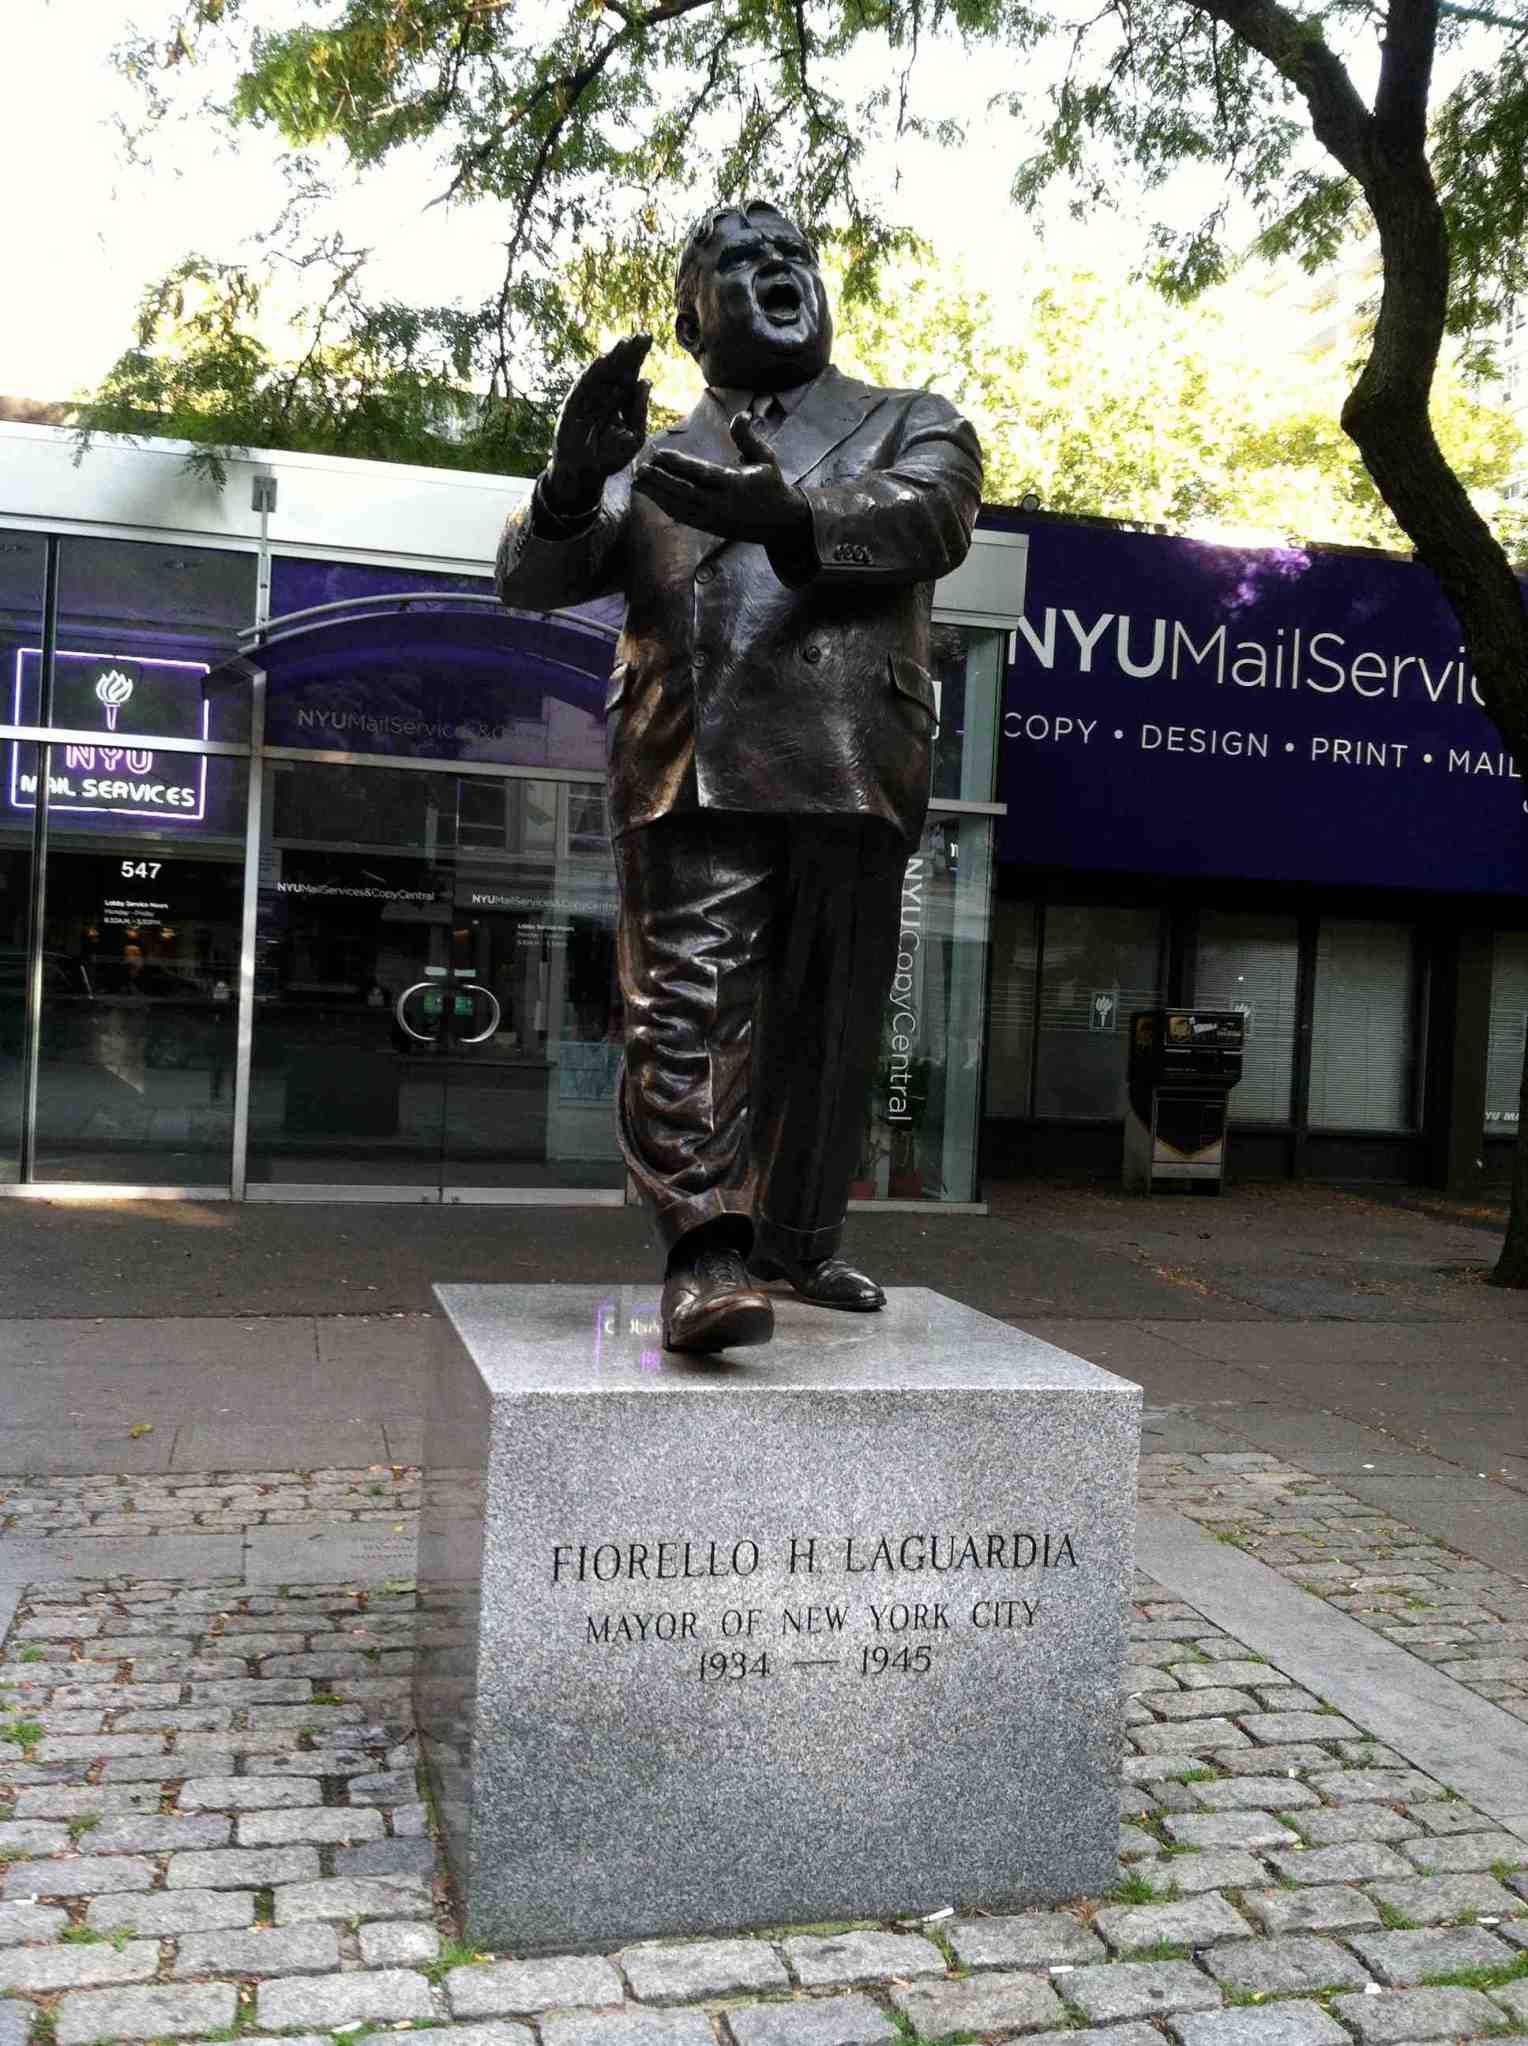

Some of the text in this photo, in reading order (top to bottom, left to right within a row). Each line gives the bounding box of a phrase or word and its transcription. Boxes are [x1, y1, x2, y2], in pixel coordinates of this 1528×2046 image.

[65, 744, 153, 775] NYU
[1004, 712, 1522, 778] COPY DESIGN PRINT MAIL
[82, 778, 196, 807] SERVICES
[121, 861, 162, 879] 547
[879, 857, 924, 1121] NYUCopyCentral
[552, 1533, 1080, 1583] FIORELLO H LAGUARDIA
[585, 1599, 1042, 1645] MAYOR OF NEW YORK CITY
[699, 1645, 933, 1681] 1934 1945
